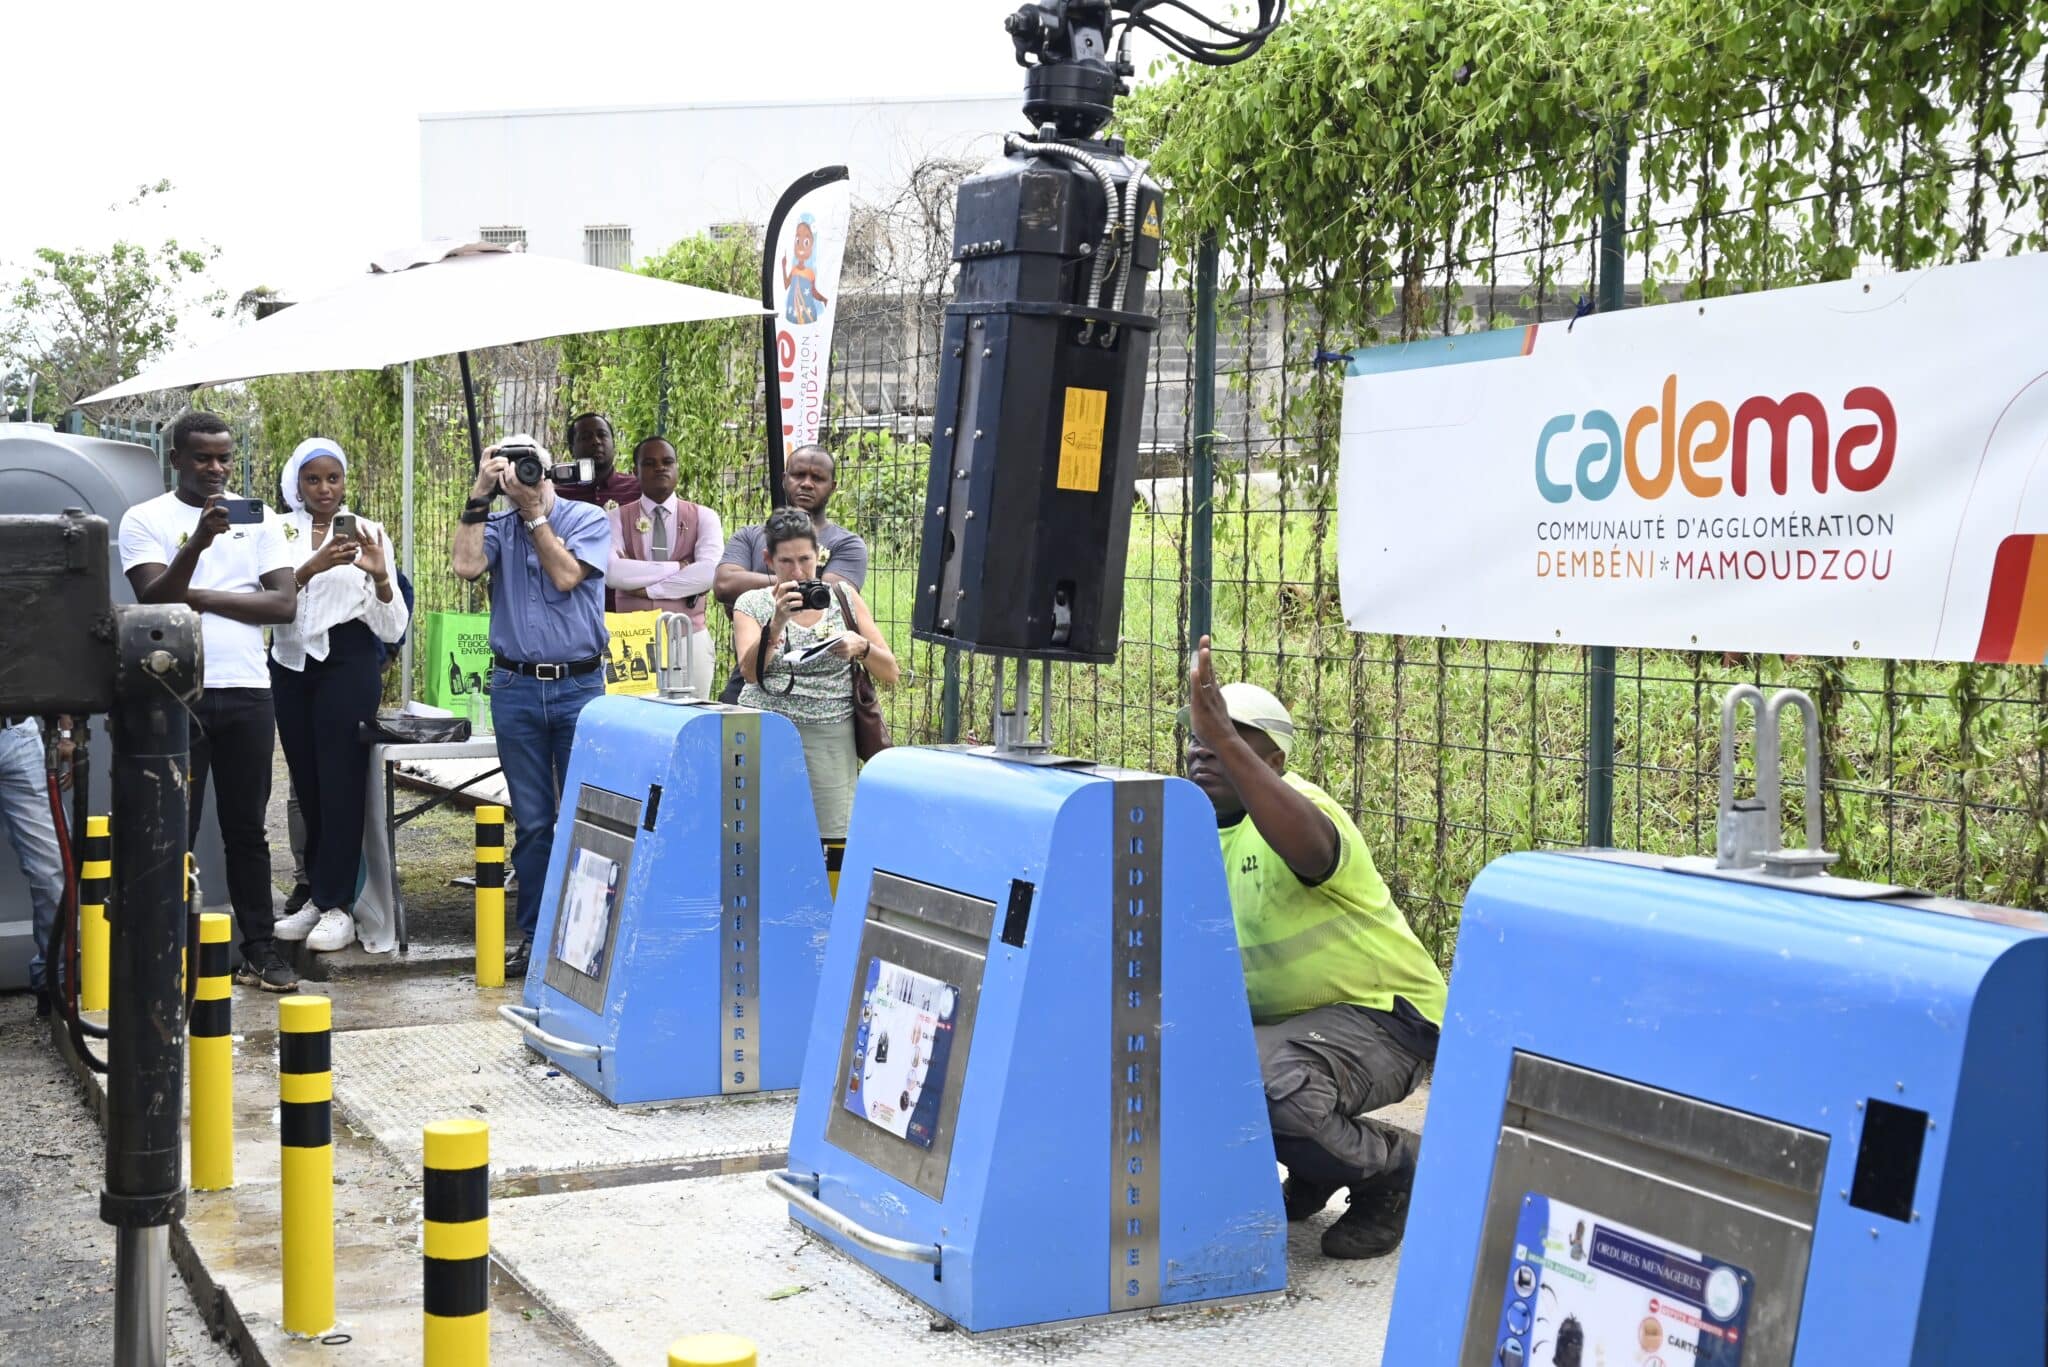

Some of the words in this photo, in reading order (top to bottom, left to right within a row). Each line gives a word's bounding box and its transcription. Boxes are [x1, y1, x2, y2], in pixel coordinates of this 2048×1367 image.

[1535, 373, 1898, 504] cadema
[1536, 514, 1666, 541] COMMUNAUTÉ
[1676, 510, 1895, 540] D'AGGLOMÉRATION
[1536, 543, 1655, 579] DEMBÉNI
[1675, 548, 1894, 581] MAMOUDZOU
[734, 731, 746, 877] ORDURES
[1128, 806, 1145, 1009] ORDURES
[1597, 1241, 1641, 1268] ORDURES
[1641, 1257, 1703, 1290] MENAGERES
